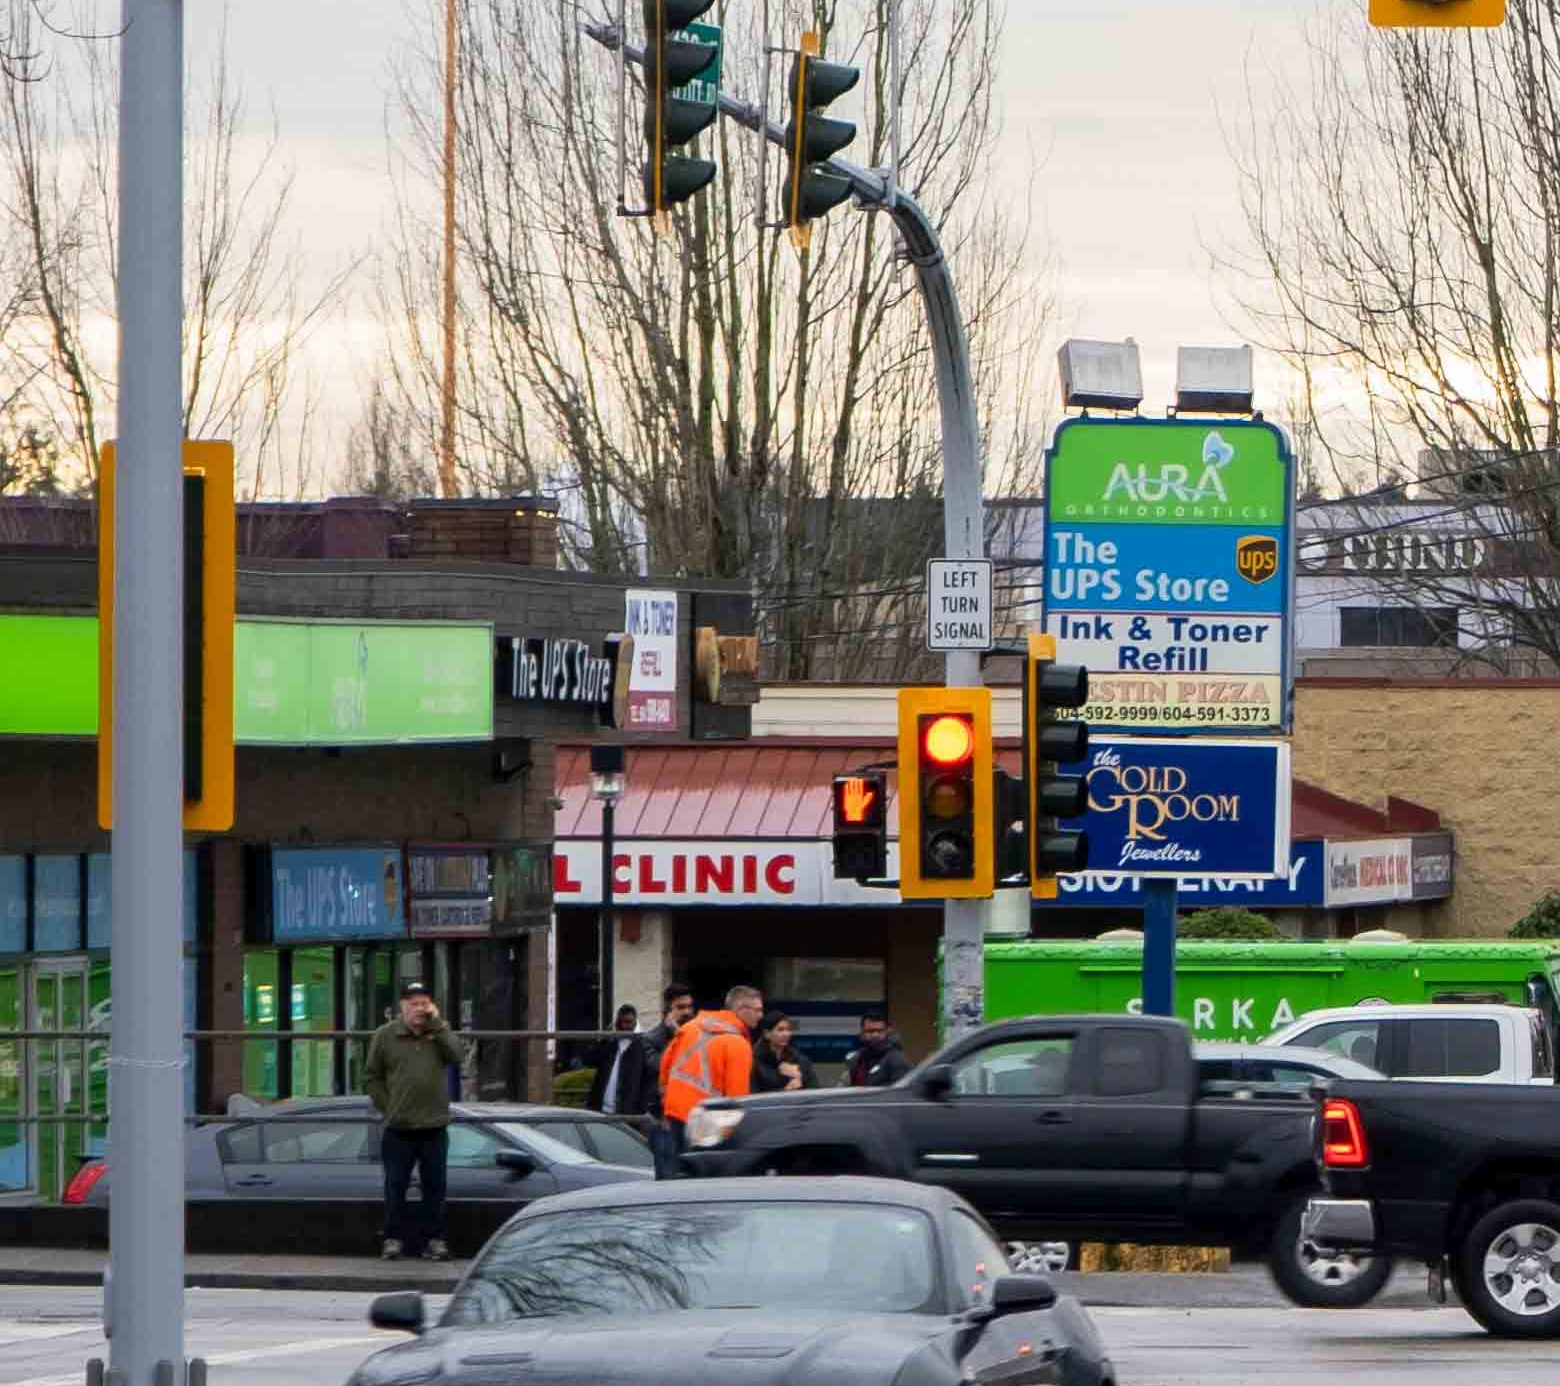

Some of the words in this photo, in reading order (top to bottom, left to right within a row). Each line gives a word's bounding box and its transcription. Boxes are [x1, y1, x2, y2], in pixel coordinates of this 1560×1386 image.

[1103, 462, 1227, 502] AURA
[1066, 503, 1269, 519] ORTHODONTICS
[1053, 532, 1118, 564] The
[1239, 550, 1275, 578] ups
[943, 571, 978, 589] LEFT
[1051, 568, 1122, 601] UPS
[1135, 569, 1230, 602] Store
[941, 596, 979, 614] TURN
[935, 622, 984, 639] SIGNAL
[1059, 616, 1113, 640] Ink
[1127, 616, 1152, 641] &
[1168, 617, 1269, 643] Toner
[512, 637, 539, 699] The
[542, 639, 569, 700] UPS
[572, 641, 611, 703] Store
[1118, 645, 1208, 671] Refill
[1177, 681, 1271, 705] PIZZA
[1093, 747, 1120, 766] the
[1087, 766, 1187, 812] GOLD
[1122, 793, 1241, 840] ROOM
[1118, 841, 1202, 867] Jewellers
[612, 855, 795, 894] CLINIC
